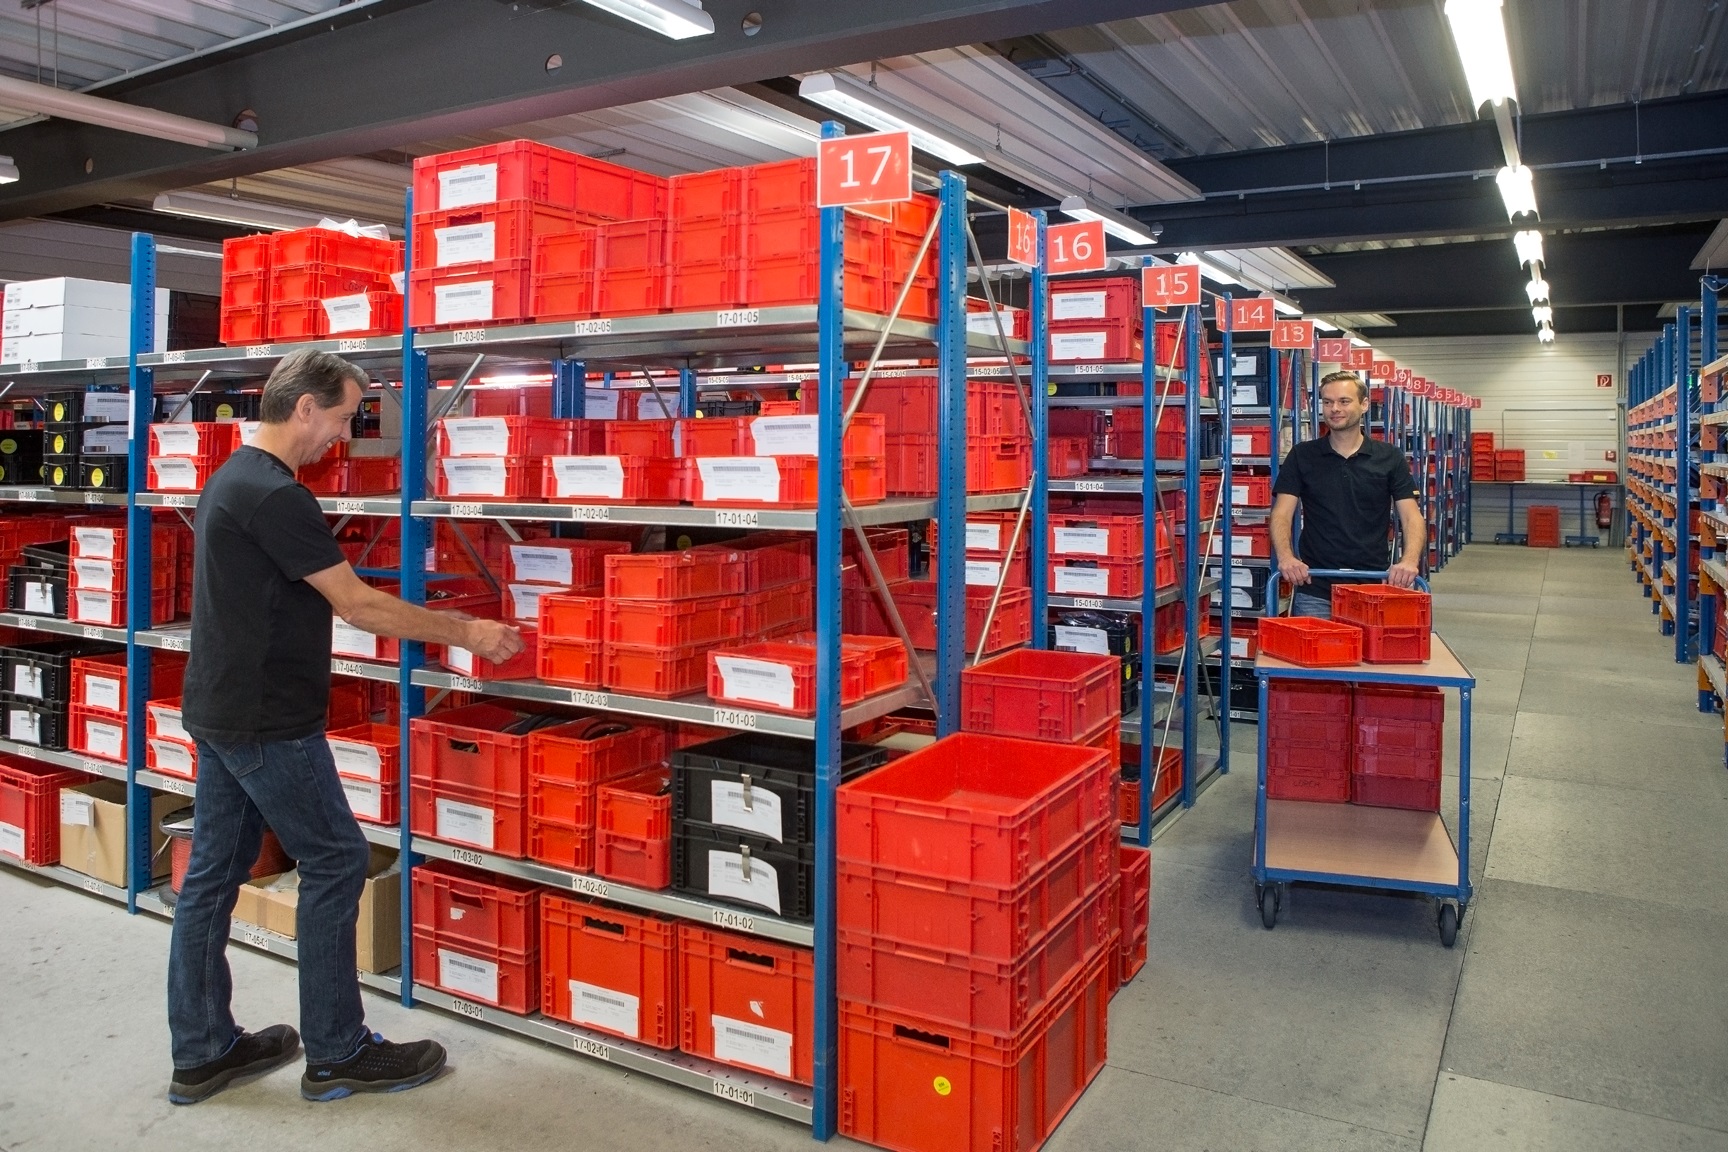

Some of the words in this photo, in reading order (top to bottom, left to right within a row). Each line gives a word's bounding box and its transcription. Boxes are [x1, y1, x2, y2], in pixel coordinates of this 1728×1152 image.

[839, 145, 893, 189] 17
[1015, 223, 1031, 255] 16
[1054, 231, 1092, 263] 16
[1155, 272, 1189, 296] 15
[718, 311, 759, 325] 17-01-05
[1237, 305, 1266, 325] 14
[576, 321, 612, 334] 17-02-05
[1280, 326, 1305, 343] 13
[454, 331, 485, 342] 17-03-05
[247, 347, 271, 357] 17-05-05
[340, 340, 367, 350] 17-04-05
[1321, 342, 1344, 358] 12
[1349, 352, 1367, 366] 11
[974, 367, 1001, 376] 15-02-05
[1075, 365, 1104, 374] 15-01-05
[1372, 364, 1390, 376] 10
[708, 376, 729, 384] 15-05-05
[1075, 482, 1104, 491] 15-01-04
[163, 496, 185, 506] 17-06-04
[337, 502, 364, 513] 17-04-04
[451, 506, 482, 516] 17-03-04
[574, 508, 608, 520] 17-02-04
[716, 513, 758, 526] 17-01-04
[1075, 599, 1103, 608] 15-01-03
[162, 639, 184, 650] 17-06-03
[336, 661, 364, 675] 17-04-03
[451, 677, 482, 691] 17-03-03
[573, 692, 608, 708] 17-02-03
[715, 711, 756, 728] 17-01-03
[84, 761, 103, 774] 17-07-02
[163, 779, 185, 793] 17-06-02
[453, 848, 483, 866] 17-03-02
[574, 878, 608, 897] 17-02-02
[714, 910, 754, 930] 17-01-02
[245, 932, 268, 949] 17-05-01
[453, 1000, 484, 1019] 17-03-01
[574, 1038, 609, 1059] 17-02-01
[714, 1082, 754, 1104] 17-01-01
